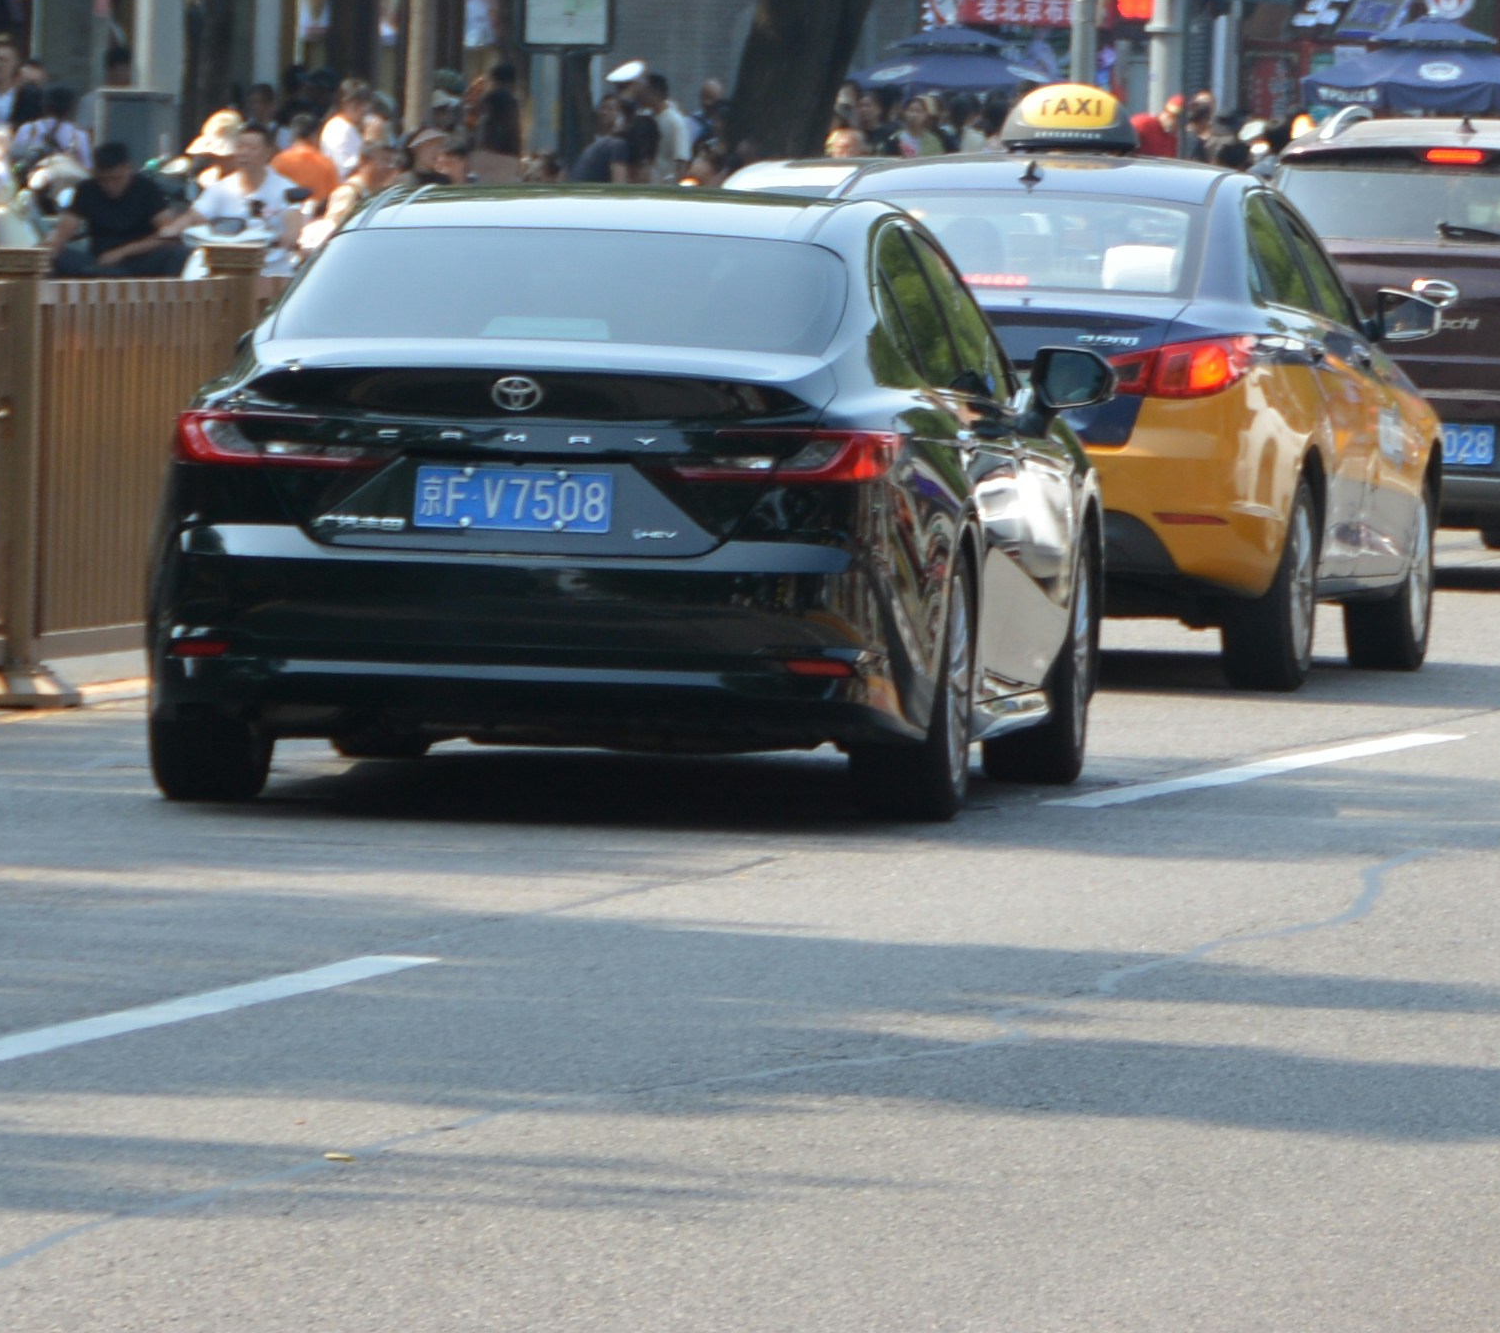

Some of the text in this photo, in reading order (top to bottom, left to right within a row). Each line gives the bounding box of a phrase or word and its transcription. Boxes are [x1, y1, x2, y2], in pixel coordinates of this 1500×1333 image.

[1040, 97, 1103, 117] TAXI
[377, 427, 657, 447] CAMRY
[1442, 429, 1490, 459] 028
